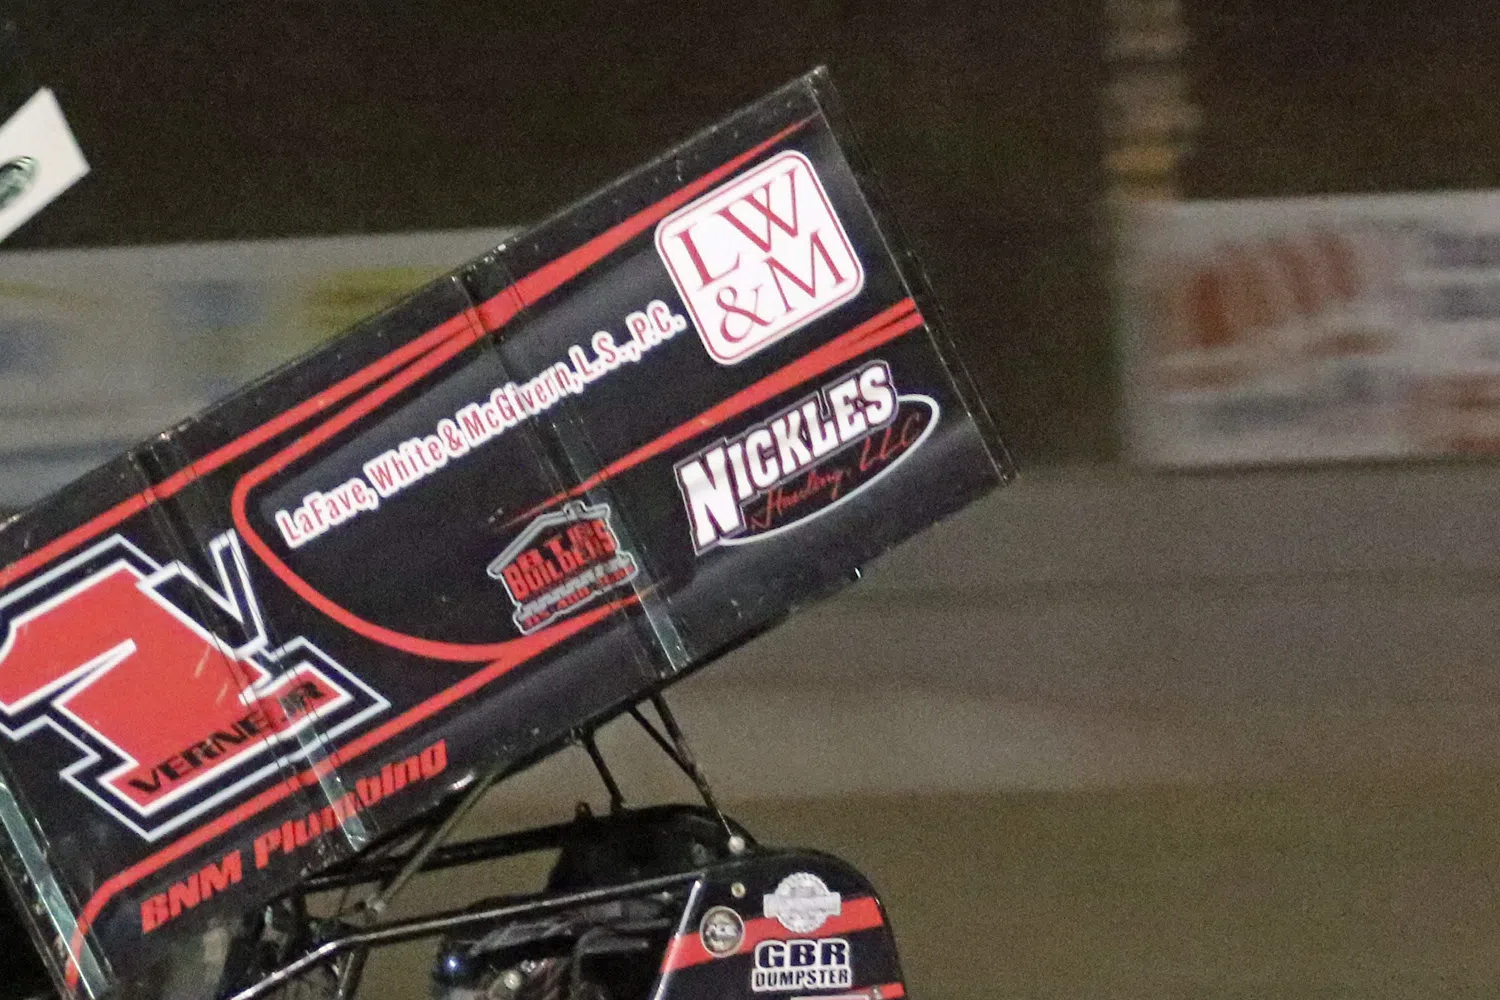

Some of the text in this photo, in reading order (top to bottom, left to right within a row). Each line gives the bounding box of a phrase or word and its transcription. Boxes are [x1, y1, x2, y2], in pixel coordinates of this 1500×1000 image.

[275, 481, 380, 549] LaFave,
[364, 434, 444, 500] White
[437, 418, 466, 461] &
[676, 362, 897, 552] NICKLES
[128, 700, 284, 796] VERNE
[754, 968, 850, 988] DUMPSTER
[757, 942, 848, 969] GBR
